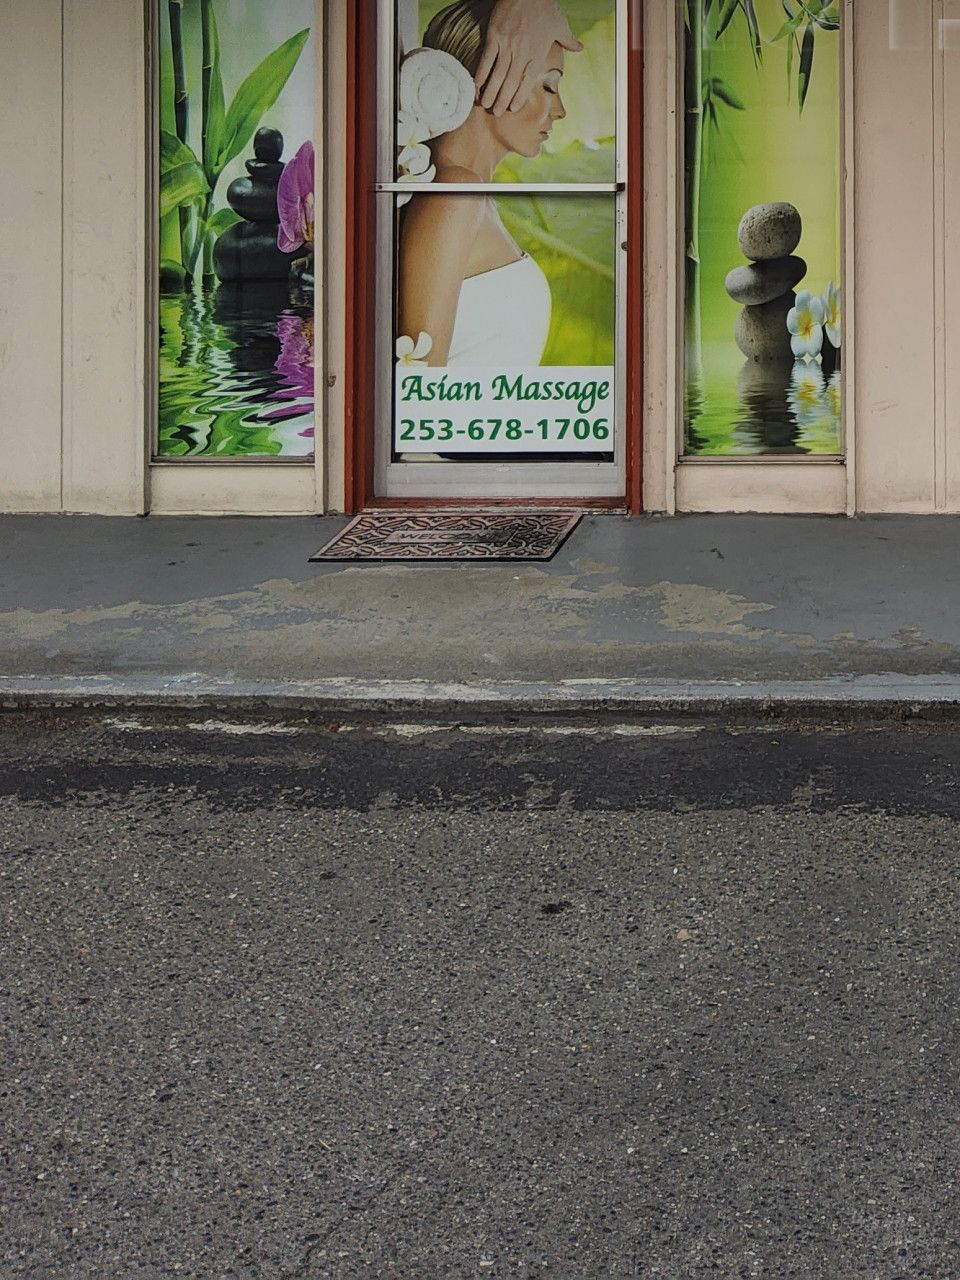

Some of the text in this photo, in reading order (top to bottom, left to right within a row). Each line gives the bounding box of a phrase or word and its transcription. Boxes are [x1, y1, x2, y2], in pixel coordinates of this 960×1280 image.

[400, 373, 610, 415] Asian Massage
[399, 417, 610, 442] 253-678-1706
